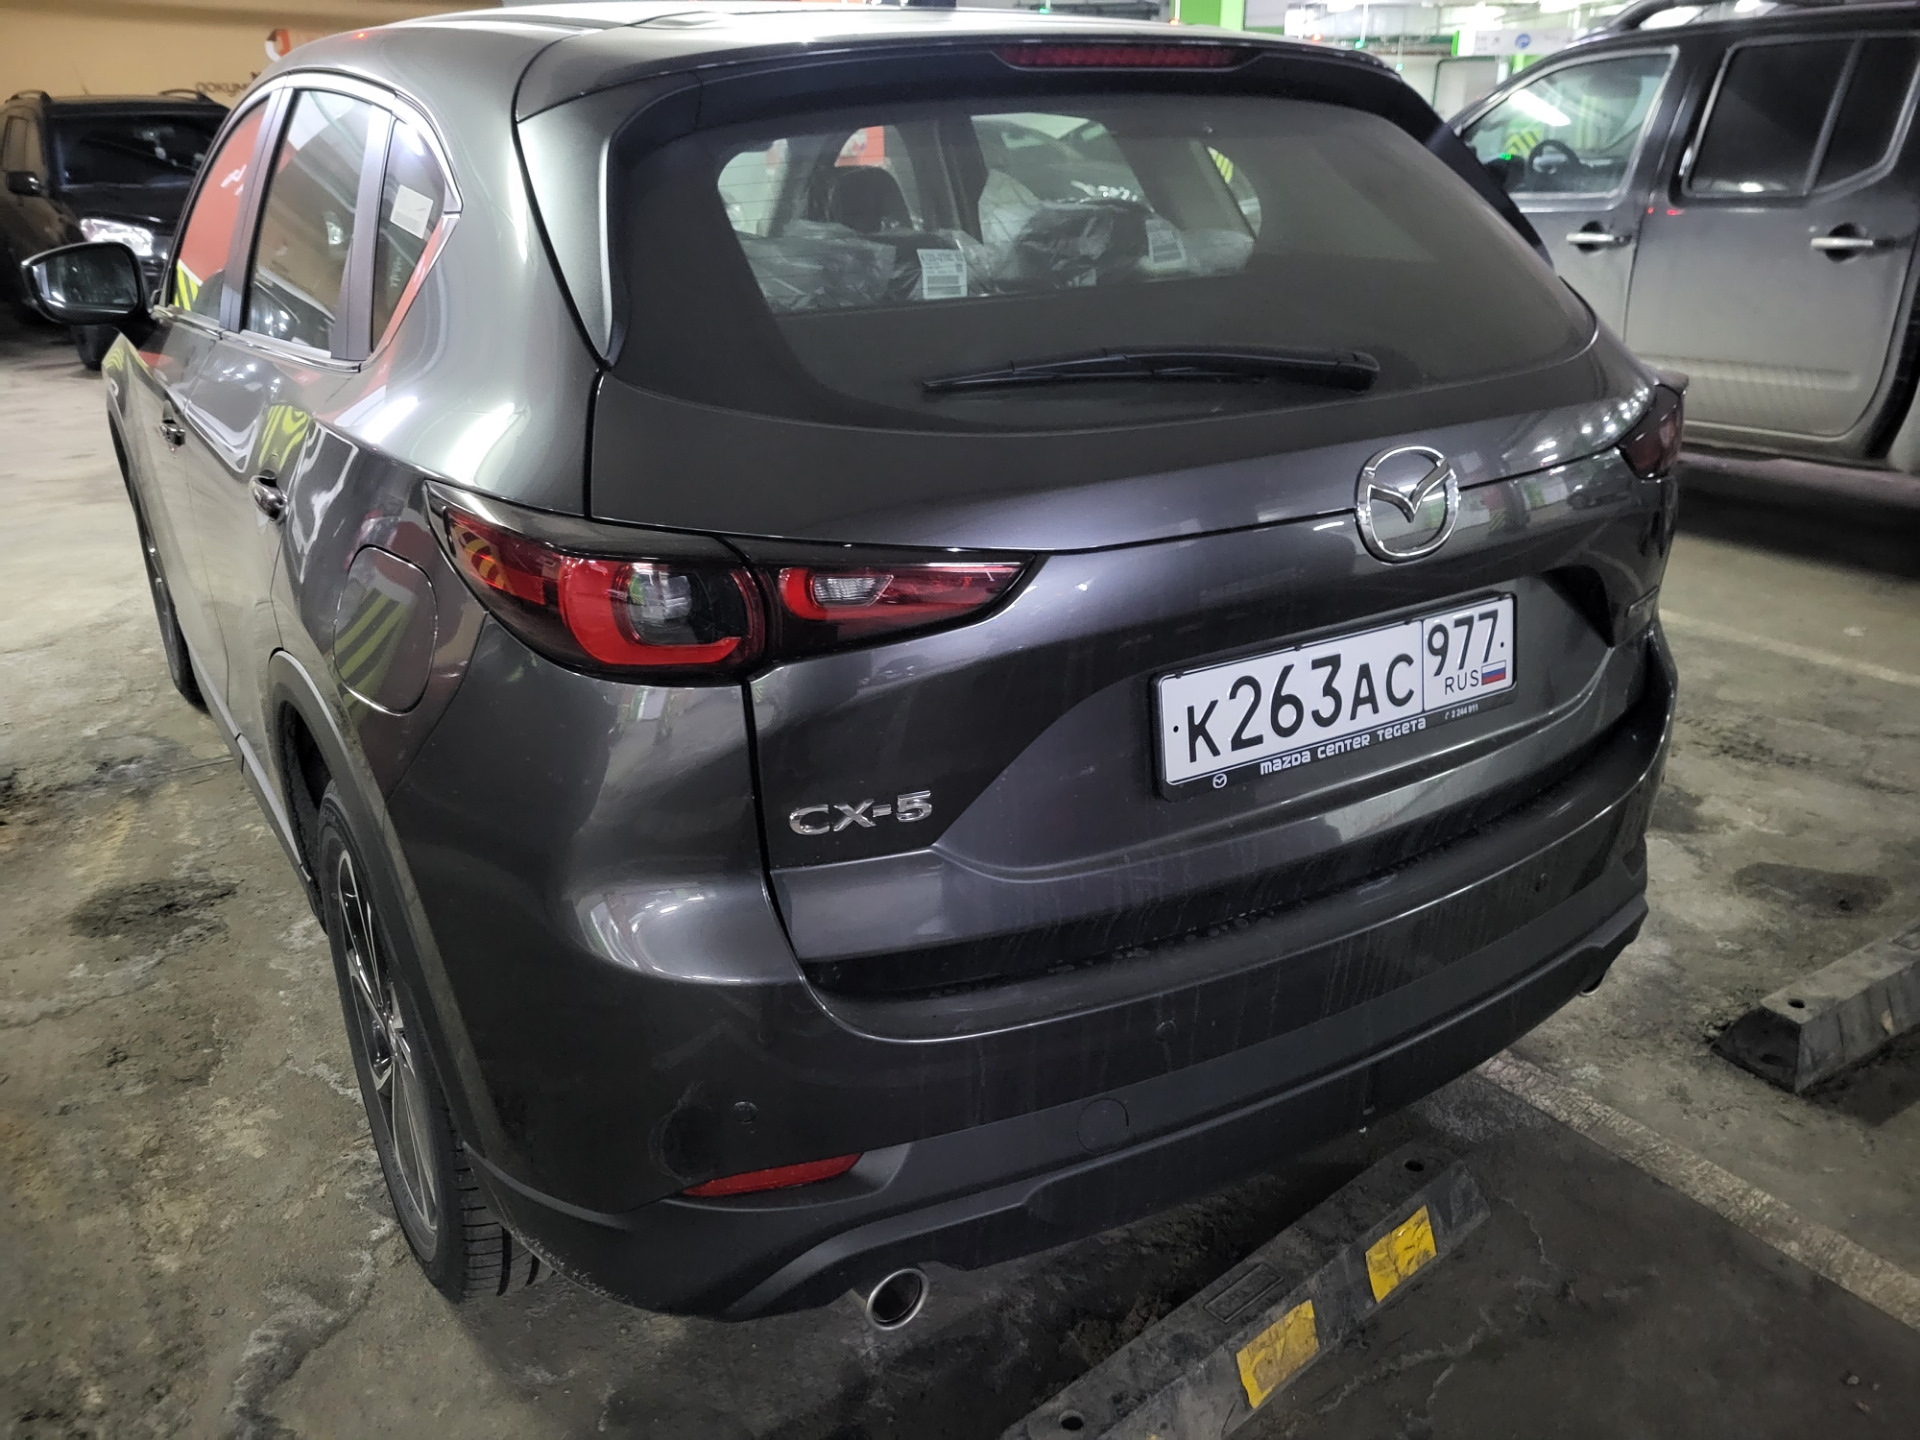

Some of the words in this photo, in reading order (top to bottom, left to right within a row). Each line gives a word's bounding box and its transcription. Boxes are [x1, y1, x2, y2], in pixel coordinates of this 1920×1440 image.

[1427, 609, 1499, 677] 977
[1444, 669, 1479, 695] RUS
[1260, 750, 1311, 775] MAZDA
[1317, 734, 1370, 759] CENTER
[1376, 717, 1426, 742] TEGETA
[789, 790, 933, 835] CX-5
